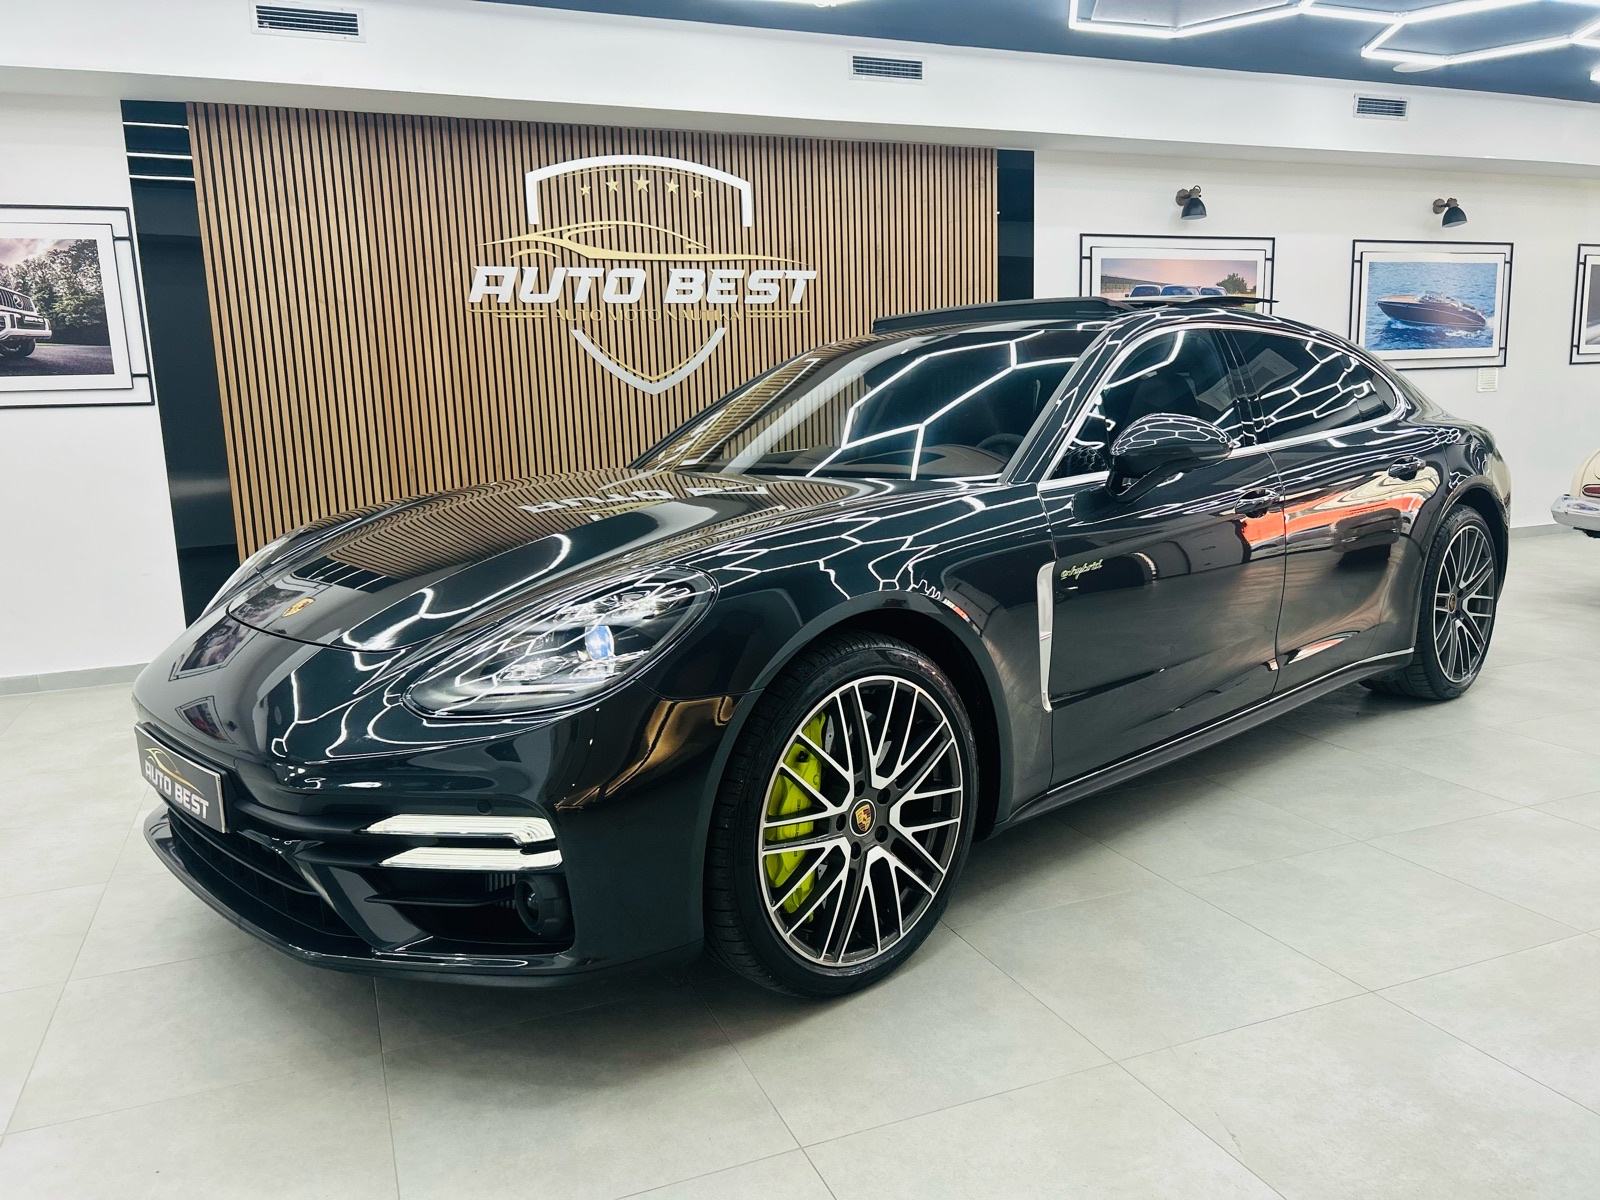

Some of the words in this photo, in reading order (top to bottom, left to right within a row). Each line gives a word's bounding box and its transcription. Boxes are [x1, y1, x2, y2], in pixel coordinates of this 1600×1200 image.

[468, 265, 647, 304] AUTO
[663, 267, 817, 304] BEST
[555, 309, 604, 322] AUTO
[145, 760, 172, 796] AUTO
[174, 781, 209, 819] BEST
